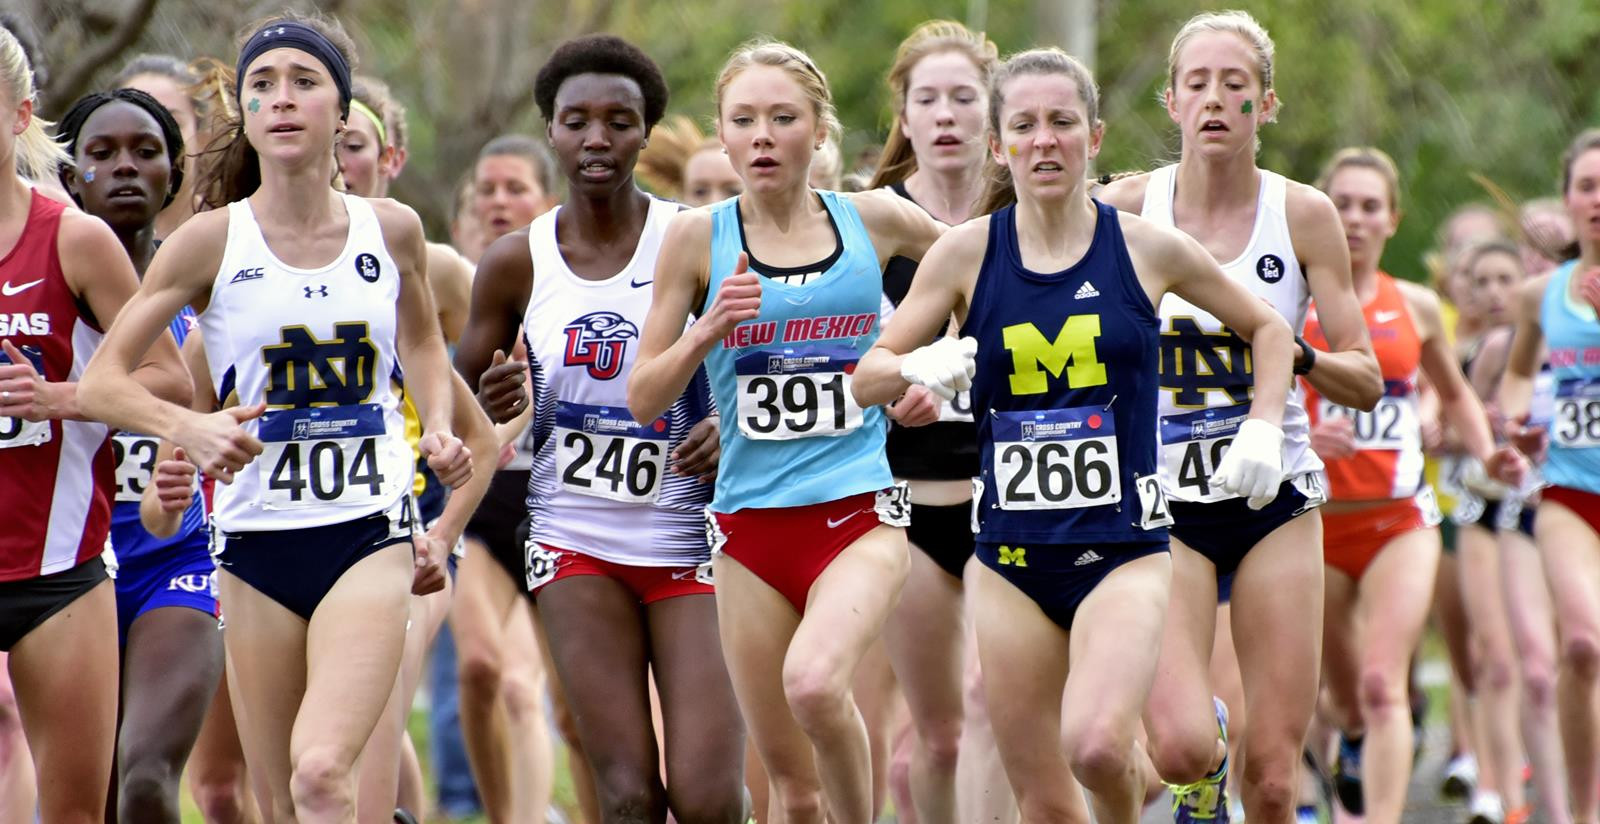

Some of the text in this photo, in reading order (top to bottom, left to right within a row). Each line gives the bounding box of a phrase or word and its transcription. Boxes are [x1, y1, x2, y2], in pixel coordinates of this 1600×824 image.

[231, 267, 265, 283] ACC
[361, 266, 377, 277] Ted
[1263, 267, 1279, 278] Ted
[1074, 290, 1100, 300] adidas
[722, 312, 877, 349] NEW MEXICO
[563, 325, 627, 381] LU
[1002, 314, 1108, 396] M
[746, 374, 846, 434] 391
[269, 437, 385, 501] 404
[563, 432, 659, 497] 246
[1001, 440, 1112, 502] 266
[998, 545, 1028, 567] M
[167, 574, 211, 592] KU
